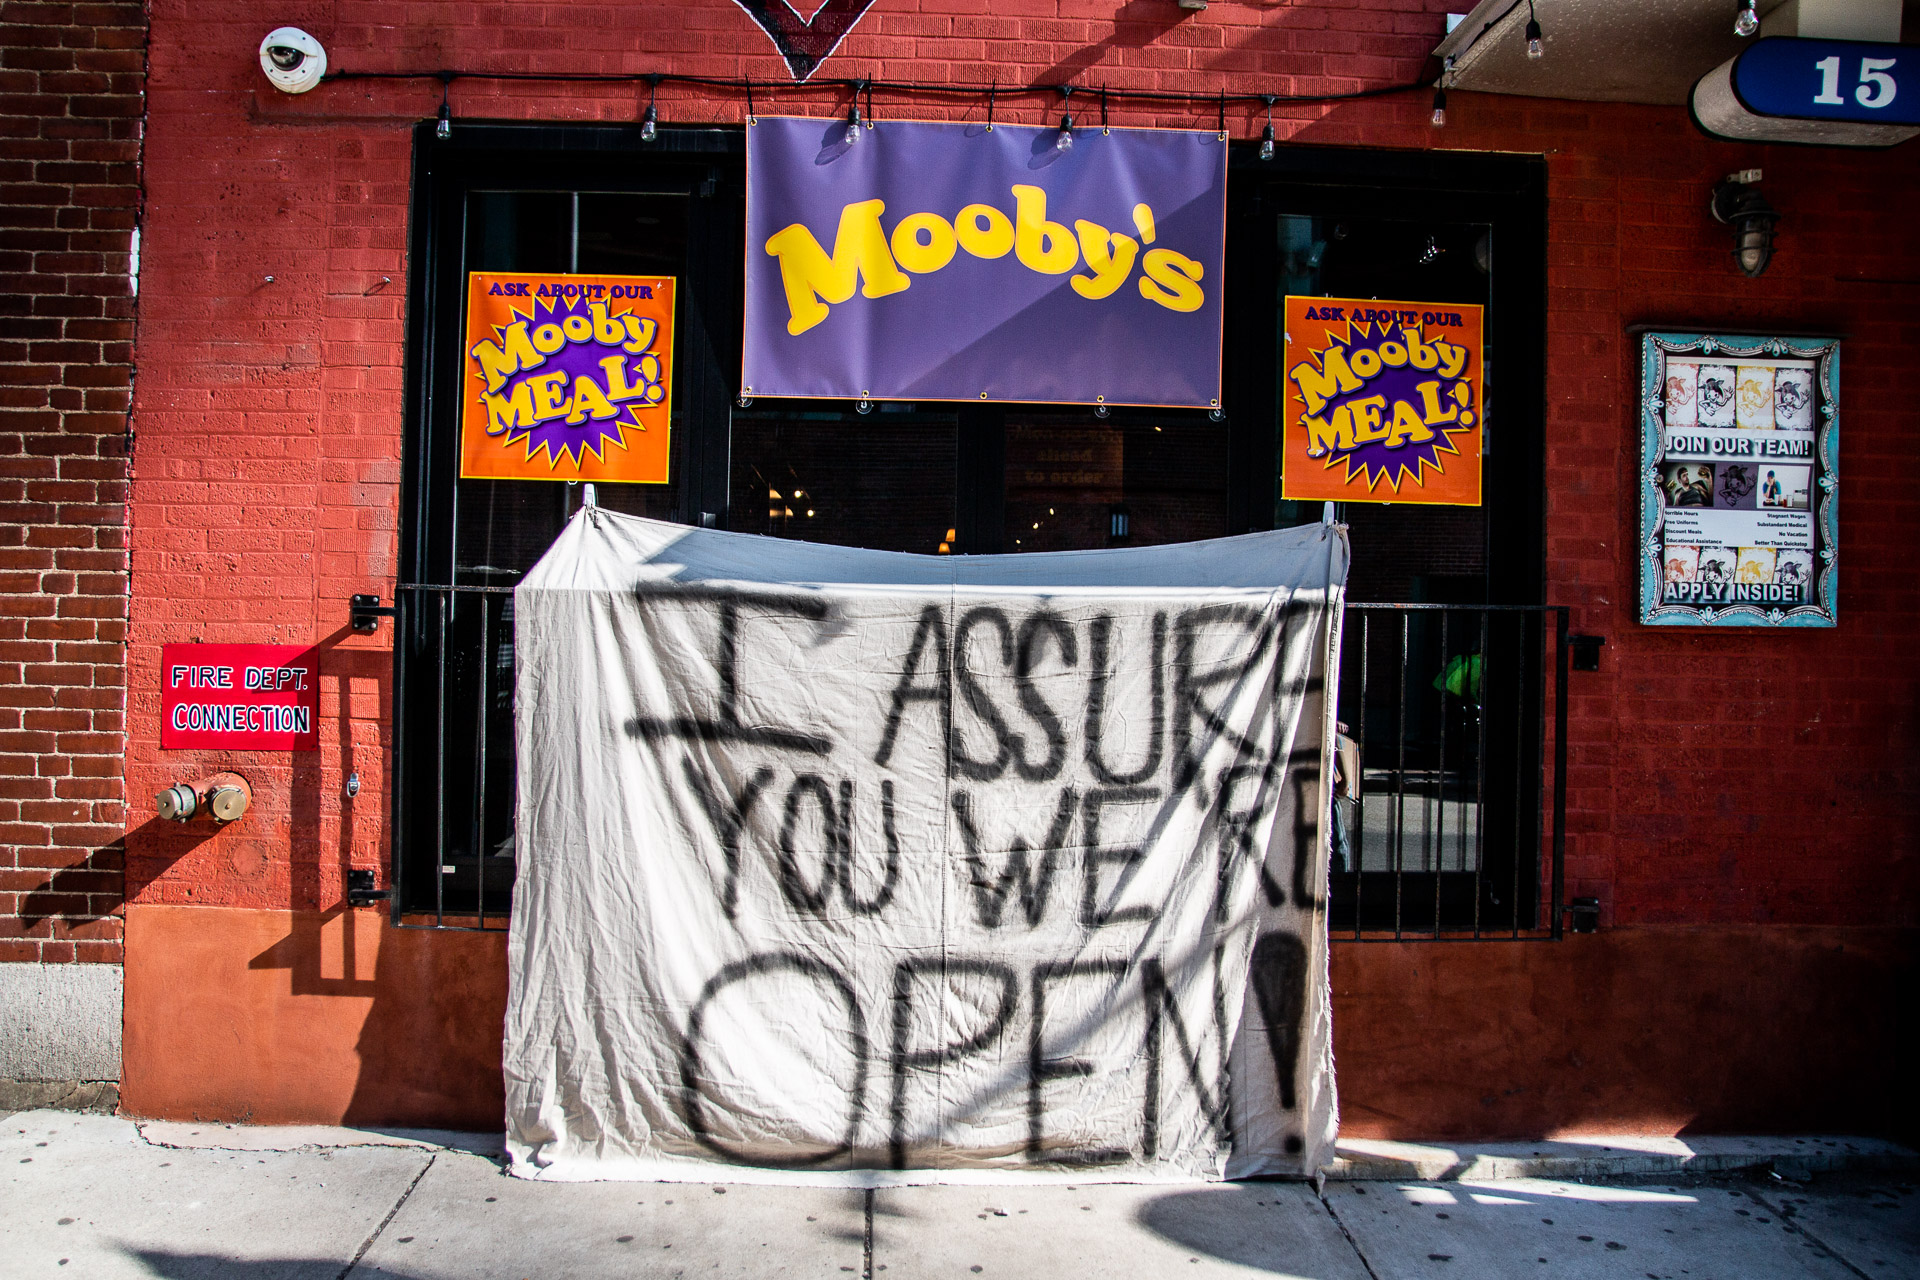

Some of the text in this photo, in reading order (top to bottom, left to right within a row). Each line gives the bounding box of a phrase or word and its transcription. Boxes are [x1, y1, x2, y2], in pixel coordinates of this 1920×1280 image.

[1813, 56, 1897, 108] 15
[488, 282, 653, 299] ASK ABOUT OUR
[765, 184, 1204, 336] Mooby's
[470, 301, 657, 395] Mooby
[1305, 306, 1463, 326] ASK ABOUT OUR
[479, 355, 665, 435] MEAL!
[1289, 328, 1467, 417] Mooby
[1300, 380, 1476, 458] MEAL!
[1665, 436, 1810, 456] JOIN OUR TEAM!
[1665, 582, 1799, 602] APPLY INSIDE!
[172, 665, 309, 690] FIRE DEPT.
[624, 581, 1324, 788] I ASSURE
[173, 703, 310, 733] CONNECTION
[682, 756, 902, 921] YOU
[680, 932, 1308, 1170] OPEN!
